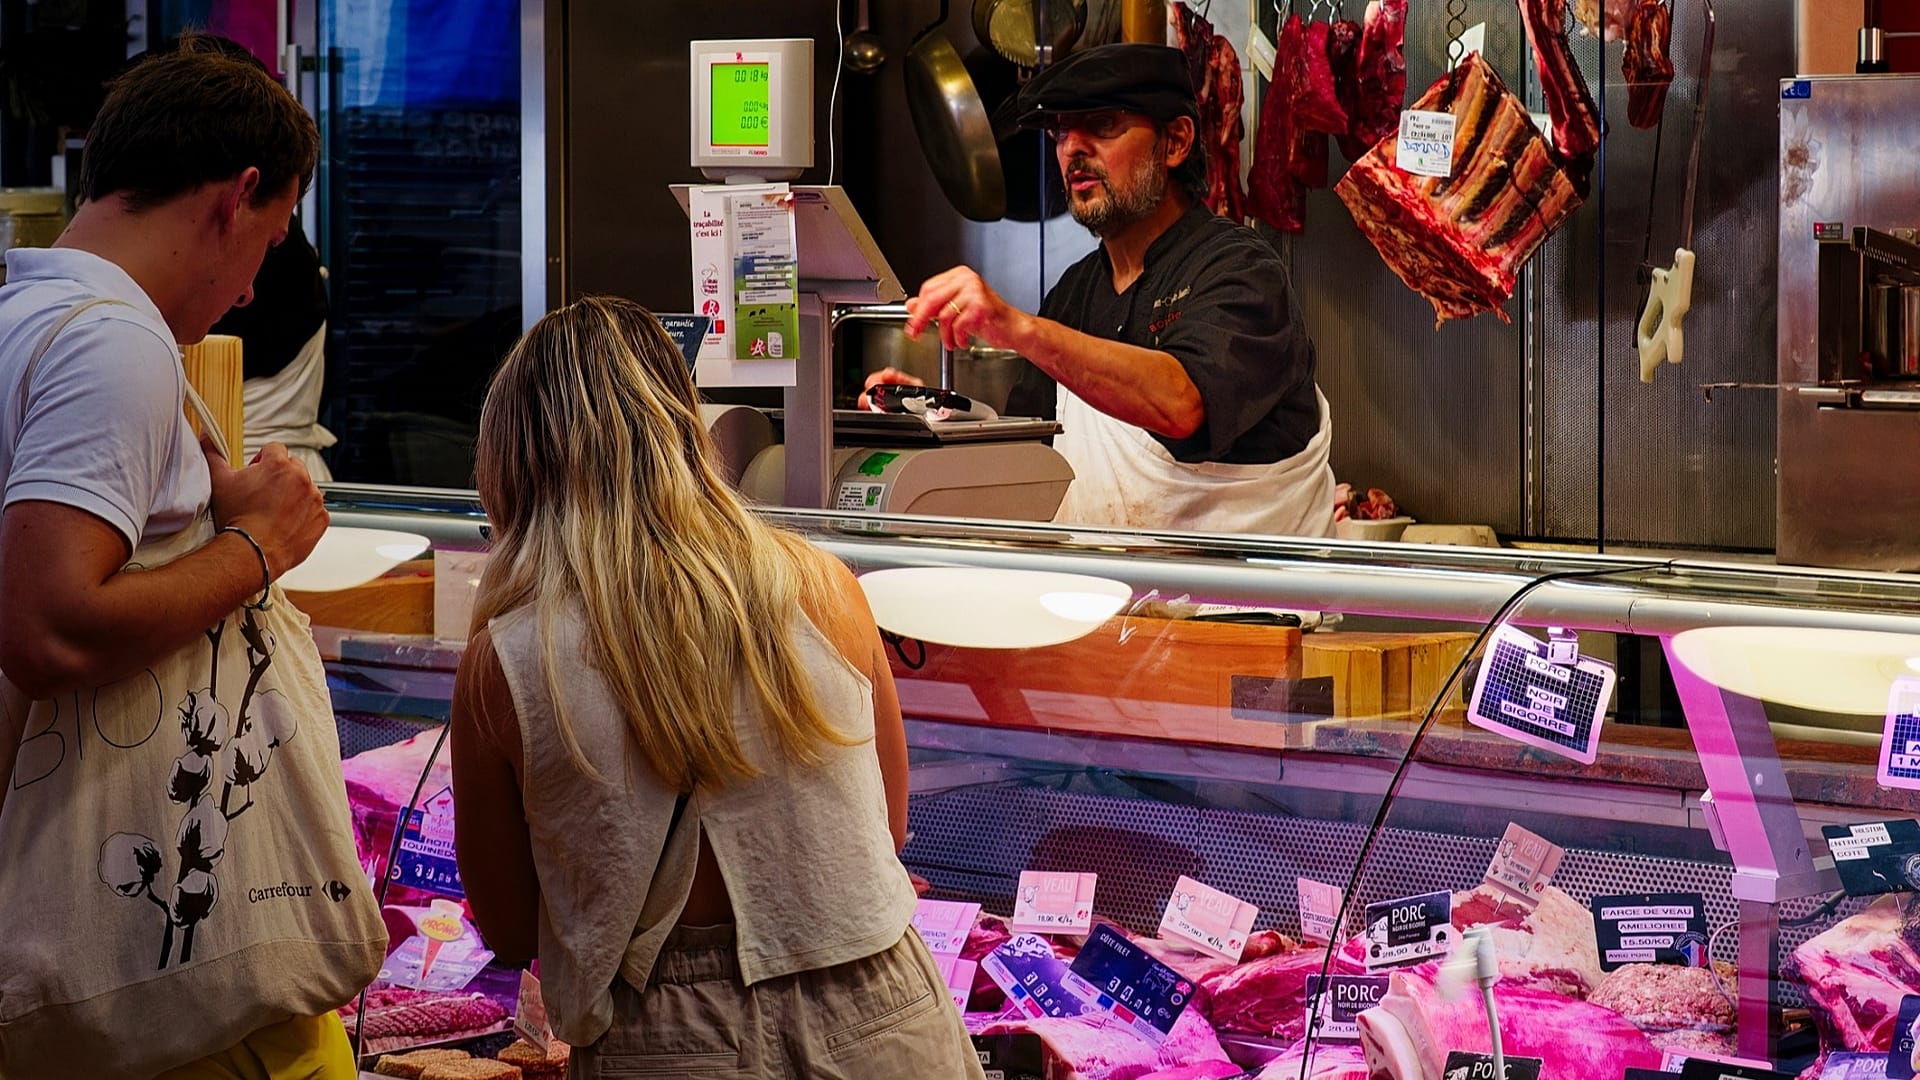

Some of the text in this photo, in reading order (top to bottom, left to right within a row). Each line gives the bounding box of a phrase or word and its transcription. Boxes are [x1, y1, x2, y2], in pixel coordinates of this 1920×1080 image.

[703, 210, 711, 218] La
[693, 219, 723, 229] traçabilité
[1529, 657, 1567, 678] PORC
[1528, 688, 1563, 707] NOIR
[1532, 701, 1553, 714] DE
[1503, 703, 1568, 733] BIGORRE
[248, 881, 313, 904] Carrefour
[1042, 877, 1074, 894] VEAU
[1392, 903, 1426, 925] PORC
[1603, 908, 1640, 917] FARCE
[422, 919, 460, 936] PROMO
[1620, 922, 1685, 931] AMELIOREE
[1114, 943, 1131, 957] FILET
[1623, 937, 1671, 947] 15.50/KG
[1338, 984, 1380, 1002] PORC
